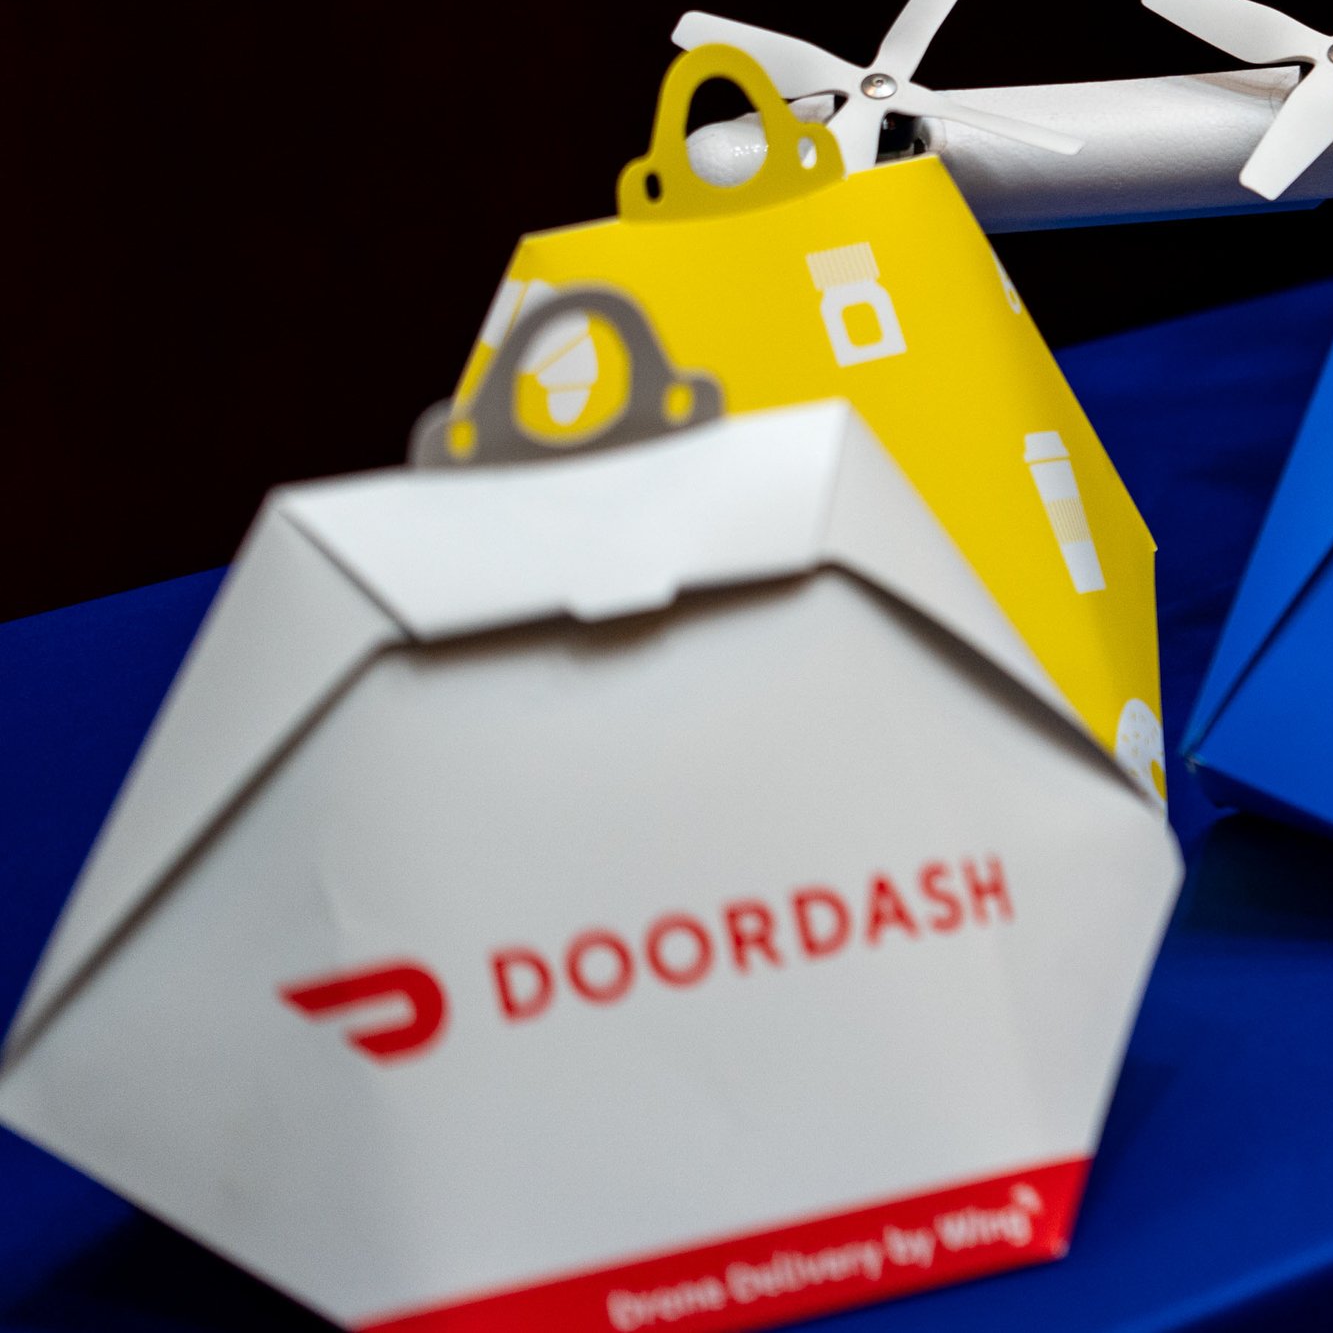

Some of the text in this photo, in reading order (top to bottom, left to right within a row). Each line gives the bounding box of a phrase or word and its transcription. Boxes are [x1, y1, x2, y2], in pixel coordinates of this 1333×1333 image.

[488, 854, 1015, 1024] DOORDASH
[606, 1276, 727, 1332] Drone
[725, 1237, 885, 1305] Delivery
[883, 1223, 937, 1269] by
